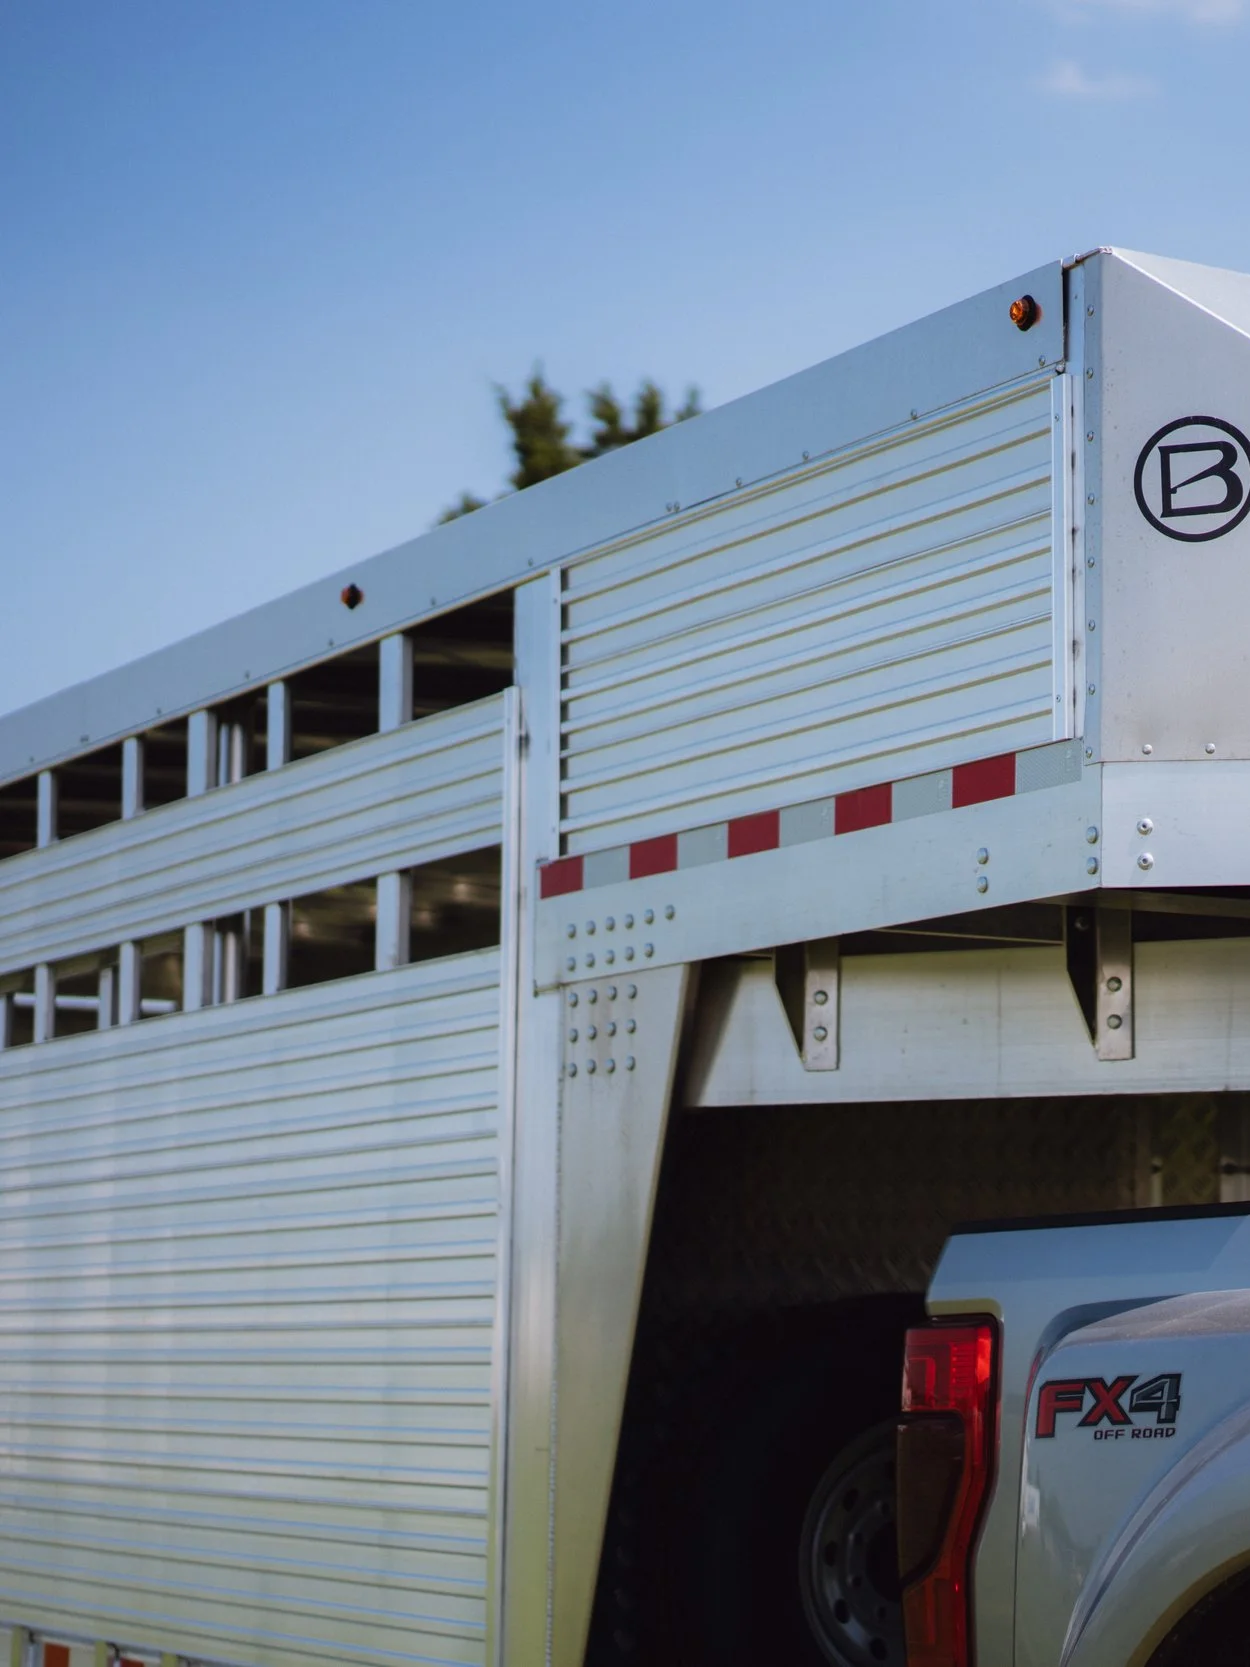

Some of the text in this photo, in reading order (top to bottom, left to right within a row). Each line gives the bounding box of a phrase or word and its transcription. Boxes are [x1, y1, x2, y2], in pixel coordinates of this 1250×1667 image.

[1158, 440, 1243, 518] B
[1035, 1373, 1182, 1439] FX4
[1094, 1428, 1176, 1440] OFF ROAD
